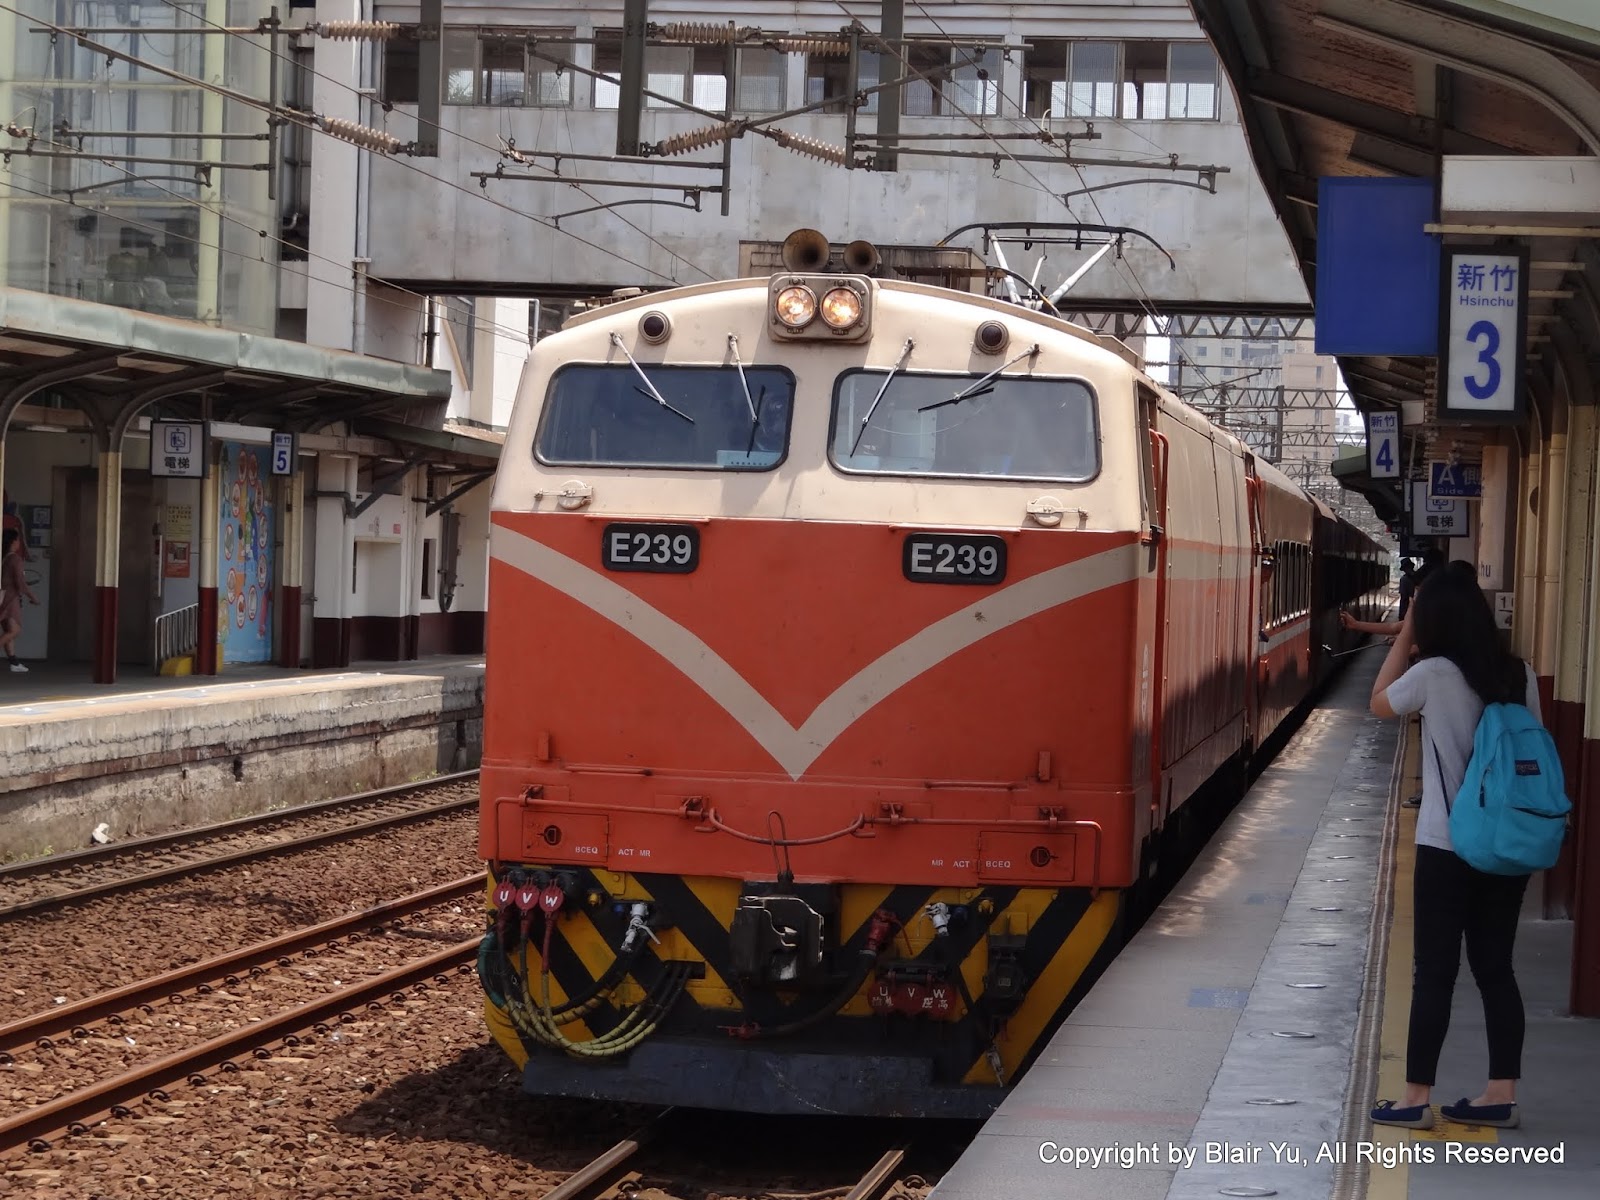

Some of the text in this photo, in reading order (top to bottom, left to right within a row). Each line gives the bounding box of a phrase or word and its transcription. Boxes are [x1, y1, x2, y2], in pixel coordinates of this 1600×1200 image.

[1457, 264, 1517, 292] 新竹
[1459, 295, 1514, 307] Hsinchu
[1464, 320, 1501, 400] 3
[1371, 415, 1396, 427] 新竹
[276, 451, 287, 471] 5
[1376, 439, 1393, 472] 4
[164, 457, 190, 469] 電梯
[1426, 515, 1454, 527] 電梯
[610, 532, 692, 564] E239
[911, 543, 998, 575] E239
[575, 846, 598, 854] BCEQ
[618, 848, 634, 856] ACT
[931, 859, 970, 868] MR ACT
[985, 860, 1011, 868] BCEQ
[500, 890, 558, 907] U V W
[879, 986, 945, 999] U V W
